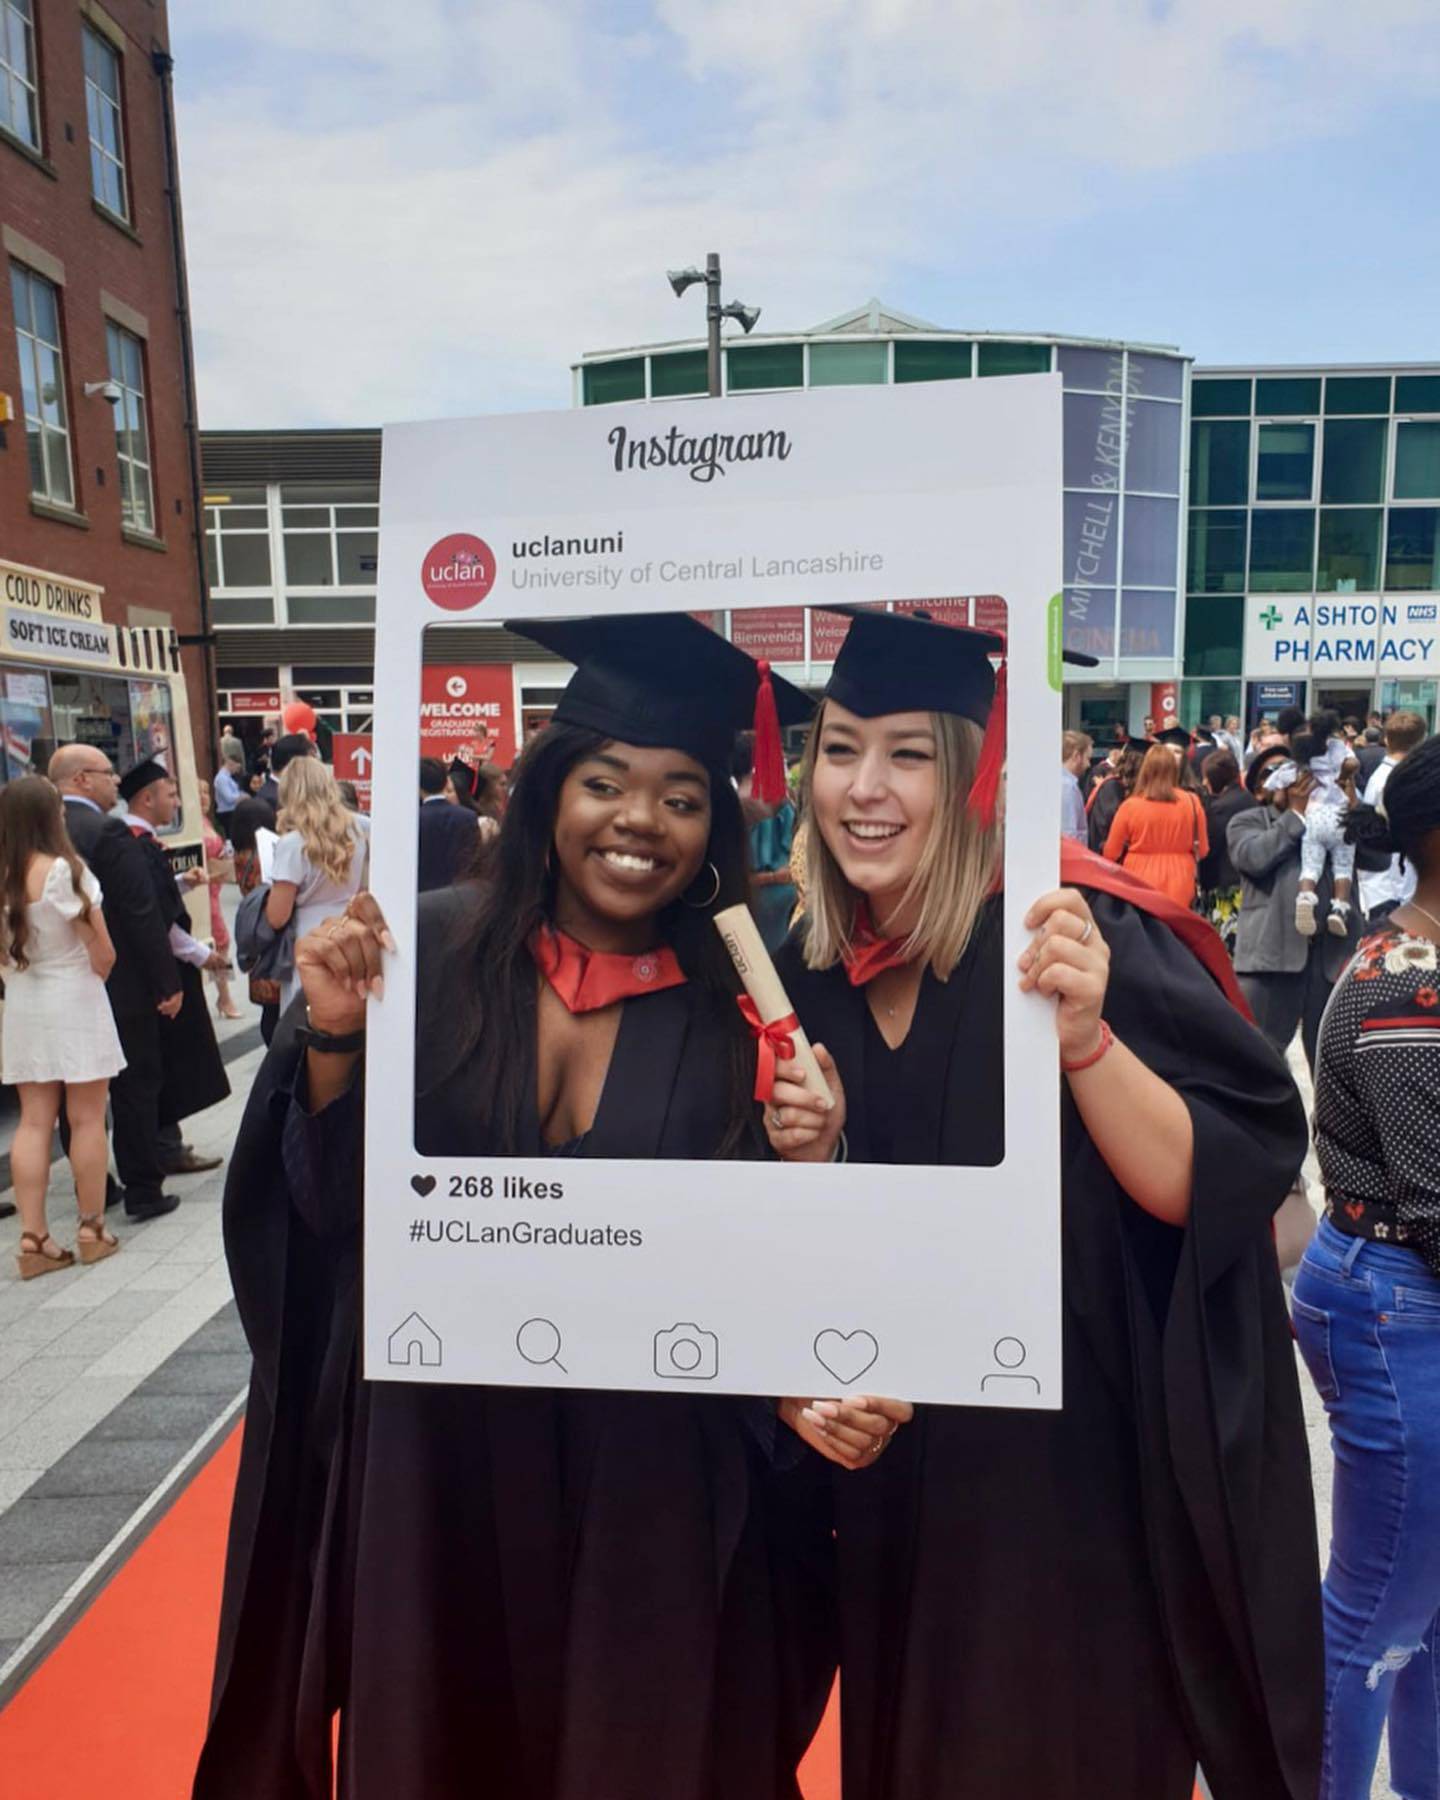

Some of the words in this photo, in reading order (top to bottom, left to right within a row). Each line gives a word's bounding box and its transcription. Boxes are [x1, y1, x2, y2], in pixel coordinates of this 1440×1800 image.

[1095, 357, 1145, 470] KENYON
[608, 425, 792, 482] Instagram
[1091, 472, 1118, 490] &
[511, 532, 624, 558] uclanuni
[430, 562, 485, 581] uclan
[511, 565, 622, 590] University
[630, 562, 652, 584] of
[659, 557, 743, 582] Central
[752, 551, 884, 577] Lancashire
[1068, 499, 1113, 621] MITCHELL
[6, 574, 41, 607] COLD
[46, 583, 92, 618] DRINKS
[1294, 605, 1397, 626] ASHTON
[1408, 606, 1434, 618] NHS
[9, 618, 44, 643] SOFT
[46, 626, 68, 647] ICE
[69, 630, 110, 654] CREAM
[733, 629, 804, 644] Bienvenida
[1066, 626, 1160, 652] CINEMA
[1274, 638, 1434, 661] PHARMACY
[420, 703, 501, 717] WELCOME
[448, 1176, 494, 1198] 268
[503, 1176, 564, 1199] likes
[409, 1220, 643, 1246] #UCLanGraduates
